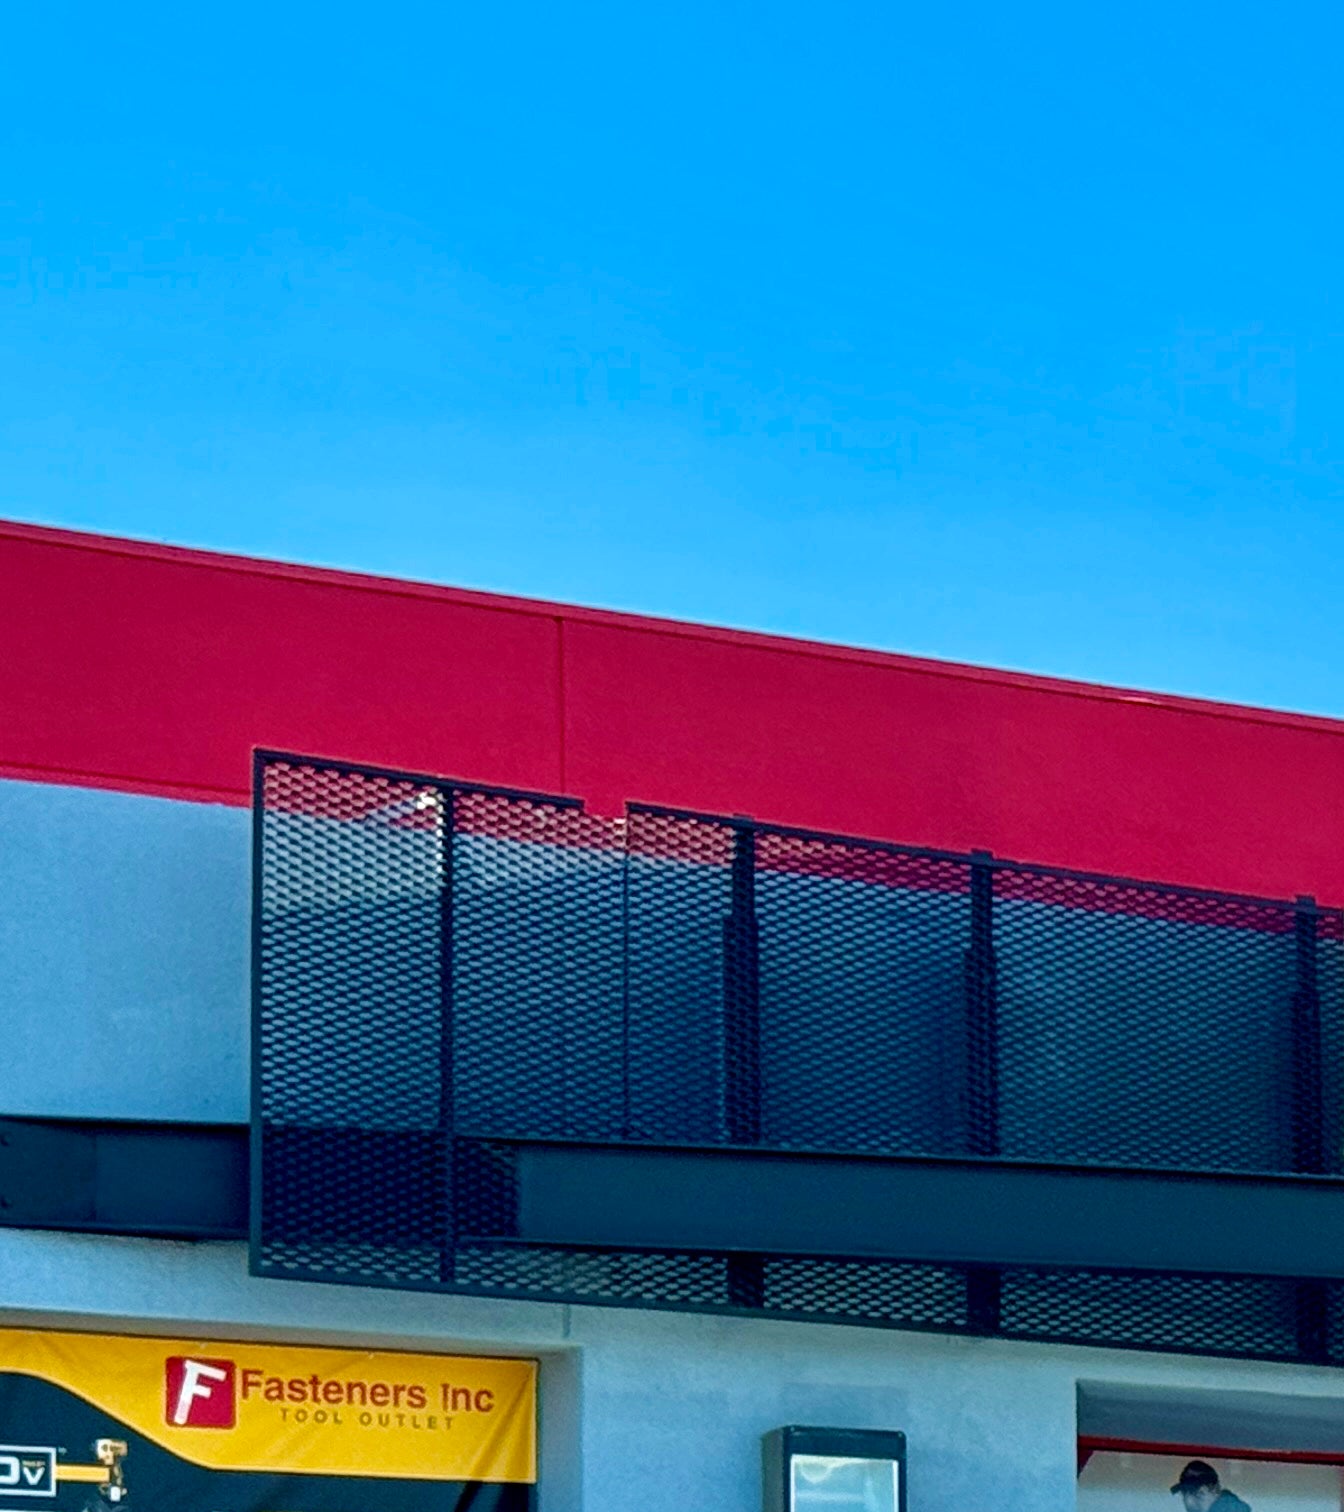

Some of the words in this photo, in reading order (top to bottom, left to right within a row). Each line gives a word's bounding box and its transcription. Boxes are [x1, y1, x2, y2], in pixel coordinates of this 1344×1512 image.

[241, 1369, 428, 1410] Fasteners
[441, 1383, 495, 1413] Inc
[281, 1407, 343, 1426] TOOL
[359, 1411, 455, 1430] OUTLET
